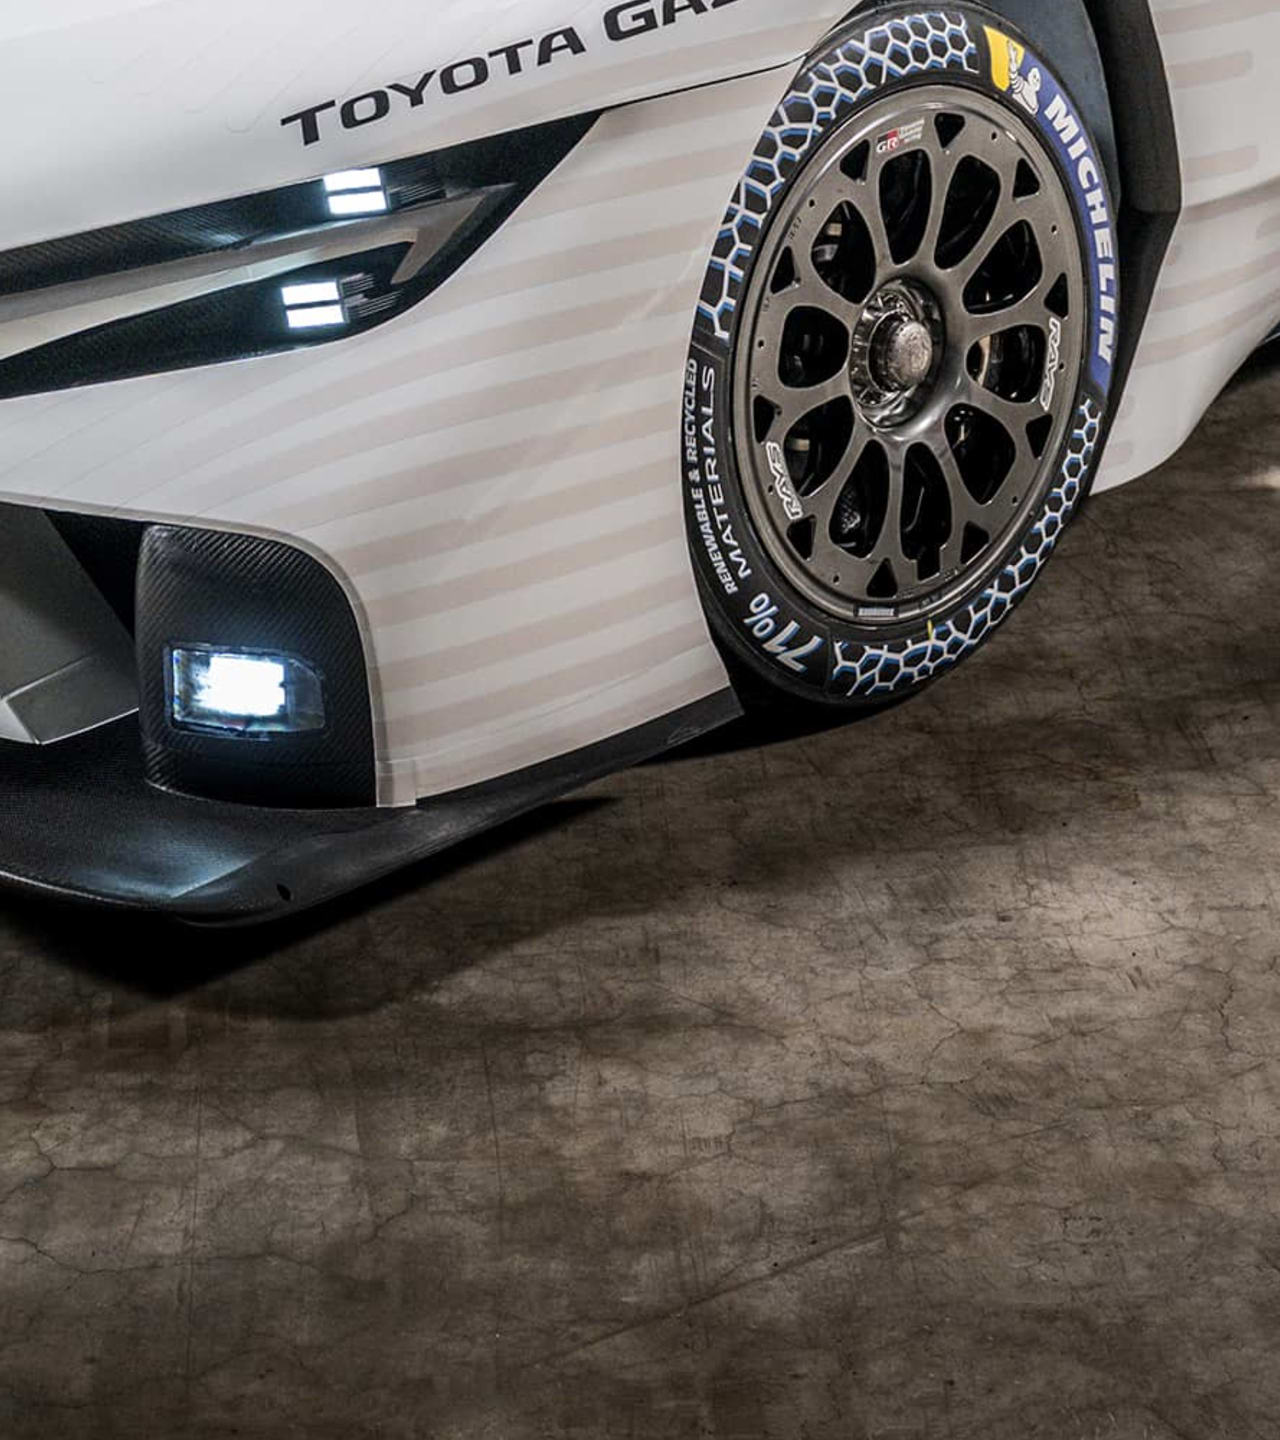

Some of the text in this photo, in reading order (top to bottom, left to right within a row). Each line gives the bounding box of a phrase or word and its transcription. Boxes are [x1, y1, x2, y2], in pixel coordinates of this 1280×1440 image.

[280, 26, 586, 147] TOYOTA
[1043, 95, 1118, 368] MICHELIN
[685, 357, 738, 595] RENEWABLE & RECYCLED
[701, 366, 752, 578] MATERIALS
[765, 440, 804, 521] RAYS
[744, 591, 828, 673] 71%
